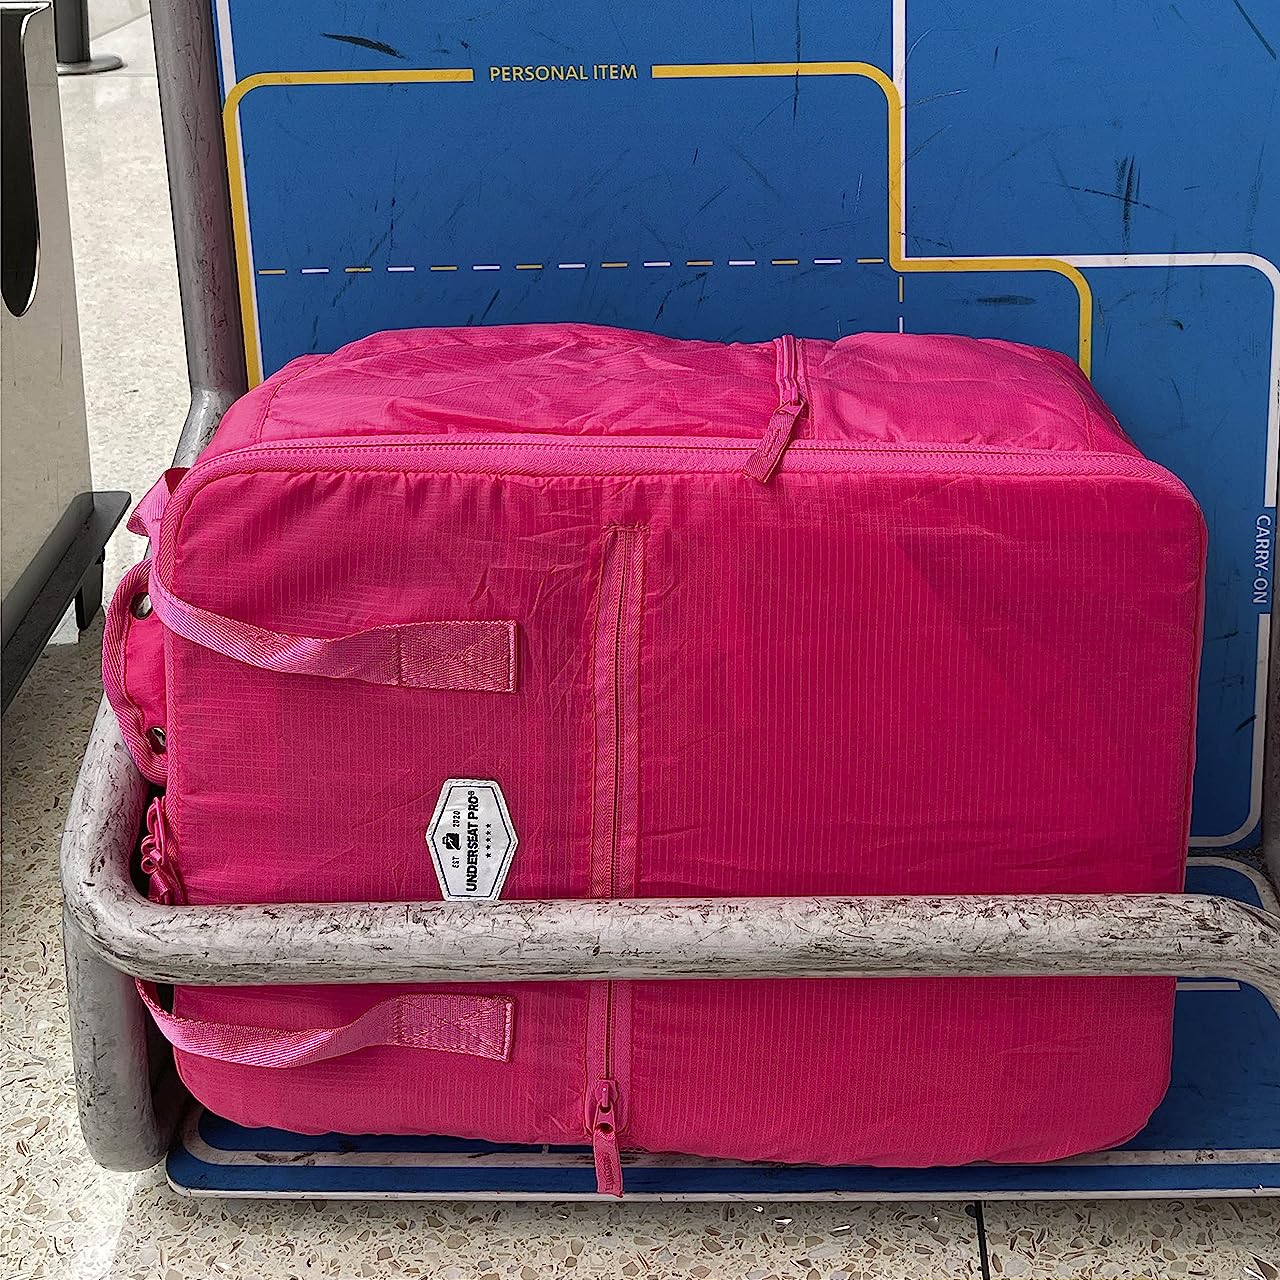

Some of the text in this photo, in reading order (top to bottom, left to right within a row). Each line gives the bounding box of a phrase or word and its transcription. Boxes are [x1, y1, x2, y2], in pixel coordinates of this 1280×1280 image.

[489, 65, 638, 82] PERSONAL ITEM
[1253, 514, 1271, 604] CARRY-ON
[451, 810, 461, 869] EST 2020
[465, 821, 479, 892] UNDERSEAT
